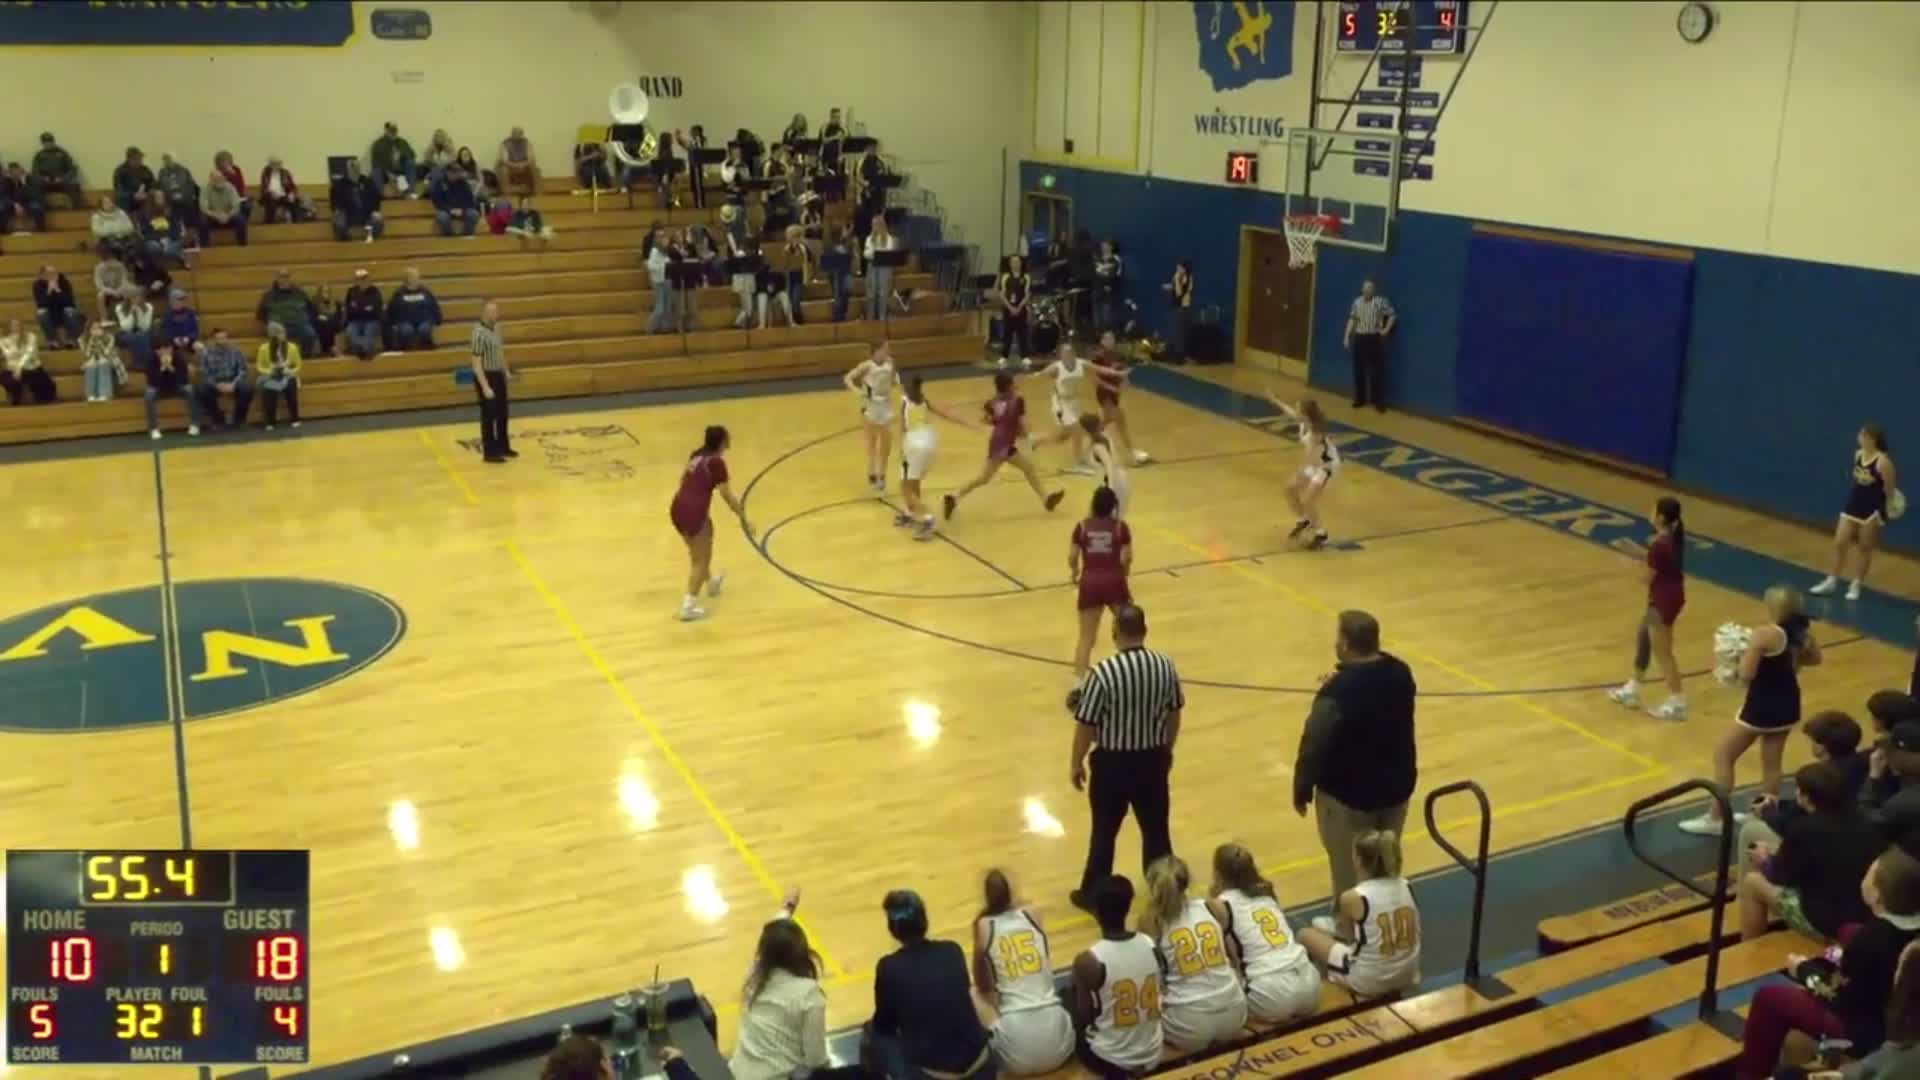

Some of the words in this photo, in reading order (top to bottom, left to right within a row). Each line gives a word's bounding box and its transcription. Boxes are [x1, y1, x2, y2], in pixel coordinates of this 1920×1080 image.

[1345, 13, 1356, 35] 5
[1440, 12, 1452, 32] 4
[1194, 114, 1285, 138] WRESTLING
[1232, 156, 1247, 179] 19
[1248, 408, 1714, 556] RNGER
[1252, 909, 1287, 948] 2
[1376, 905, 1417, 956] 10
[1168, 921, 1226, 976] 22
[1111, 974, 1161, 1029] 24
[1190, 1044, 1310, 1080] ONNEL
